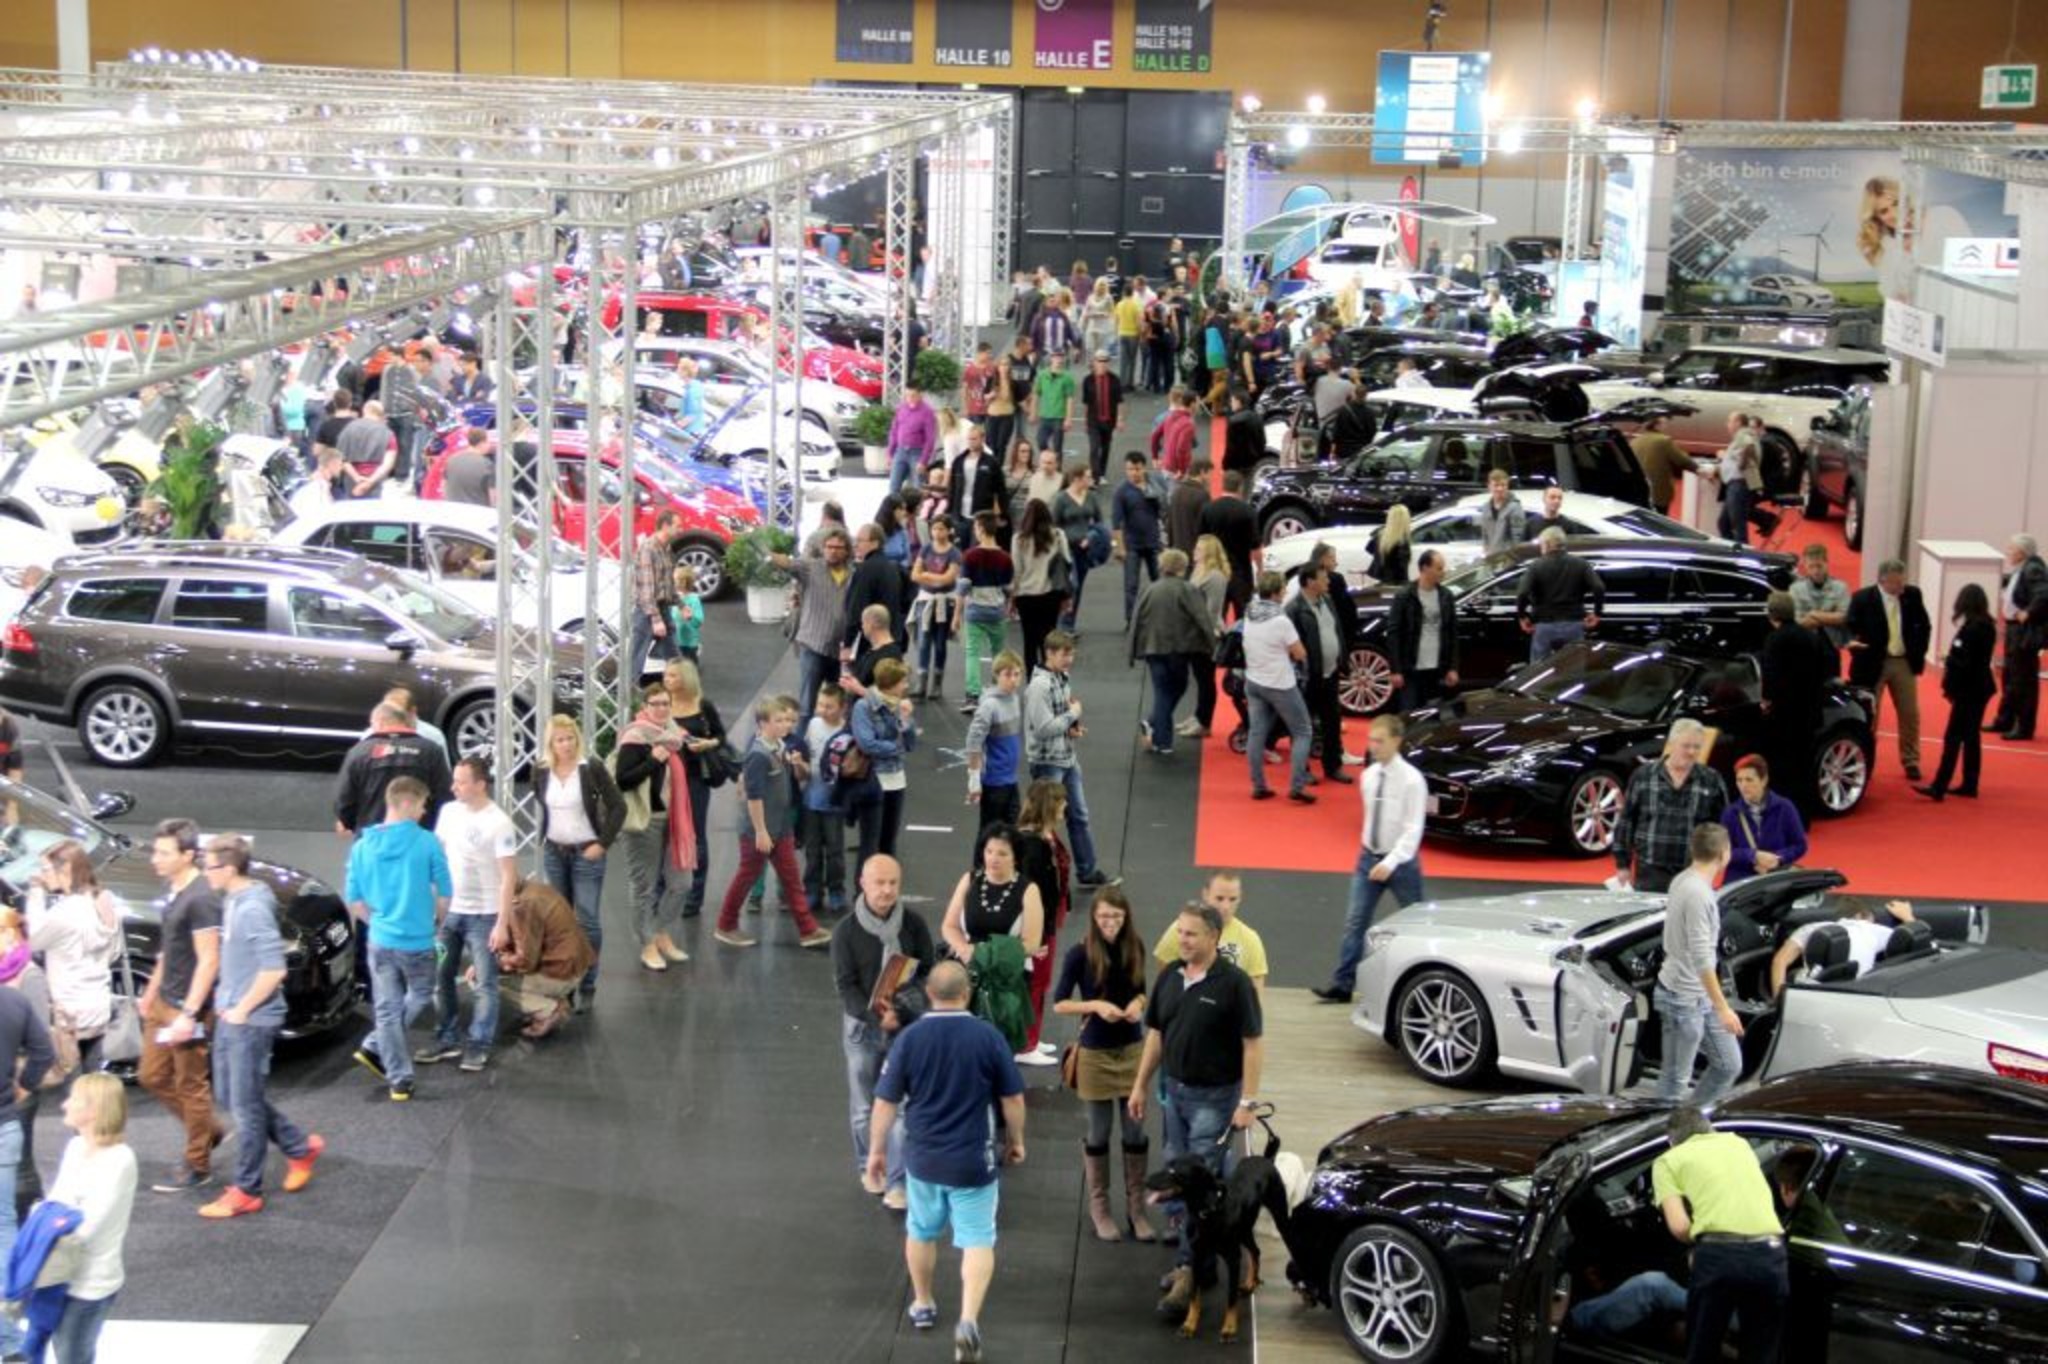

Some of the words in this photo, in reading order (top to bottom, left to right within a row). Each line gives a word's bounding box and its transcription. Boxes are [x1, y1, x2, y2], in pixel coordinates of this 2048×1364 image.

[861, 29, 897, 42] HALLE
[1135, 25, 1166, 37] HALLE
[1135, 38, 1166, 49] HALLE
[935, 48, 988, 65] HALLE
[992, 50, 1011, 66] 10
[1035, 51, 1089, 67] HALLE
[1093, 39, 1111, 69] E
[1135, 54, 1191, 70] HALLE
[1198, 55, 1209, 71] D
[1741, 161, 1773, 179] bin
